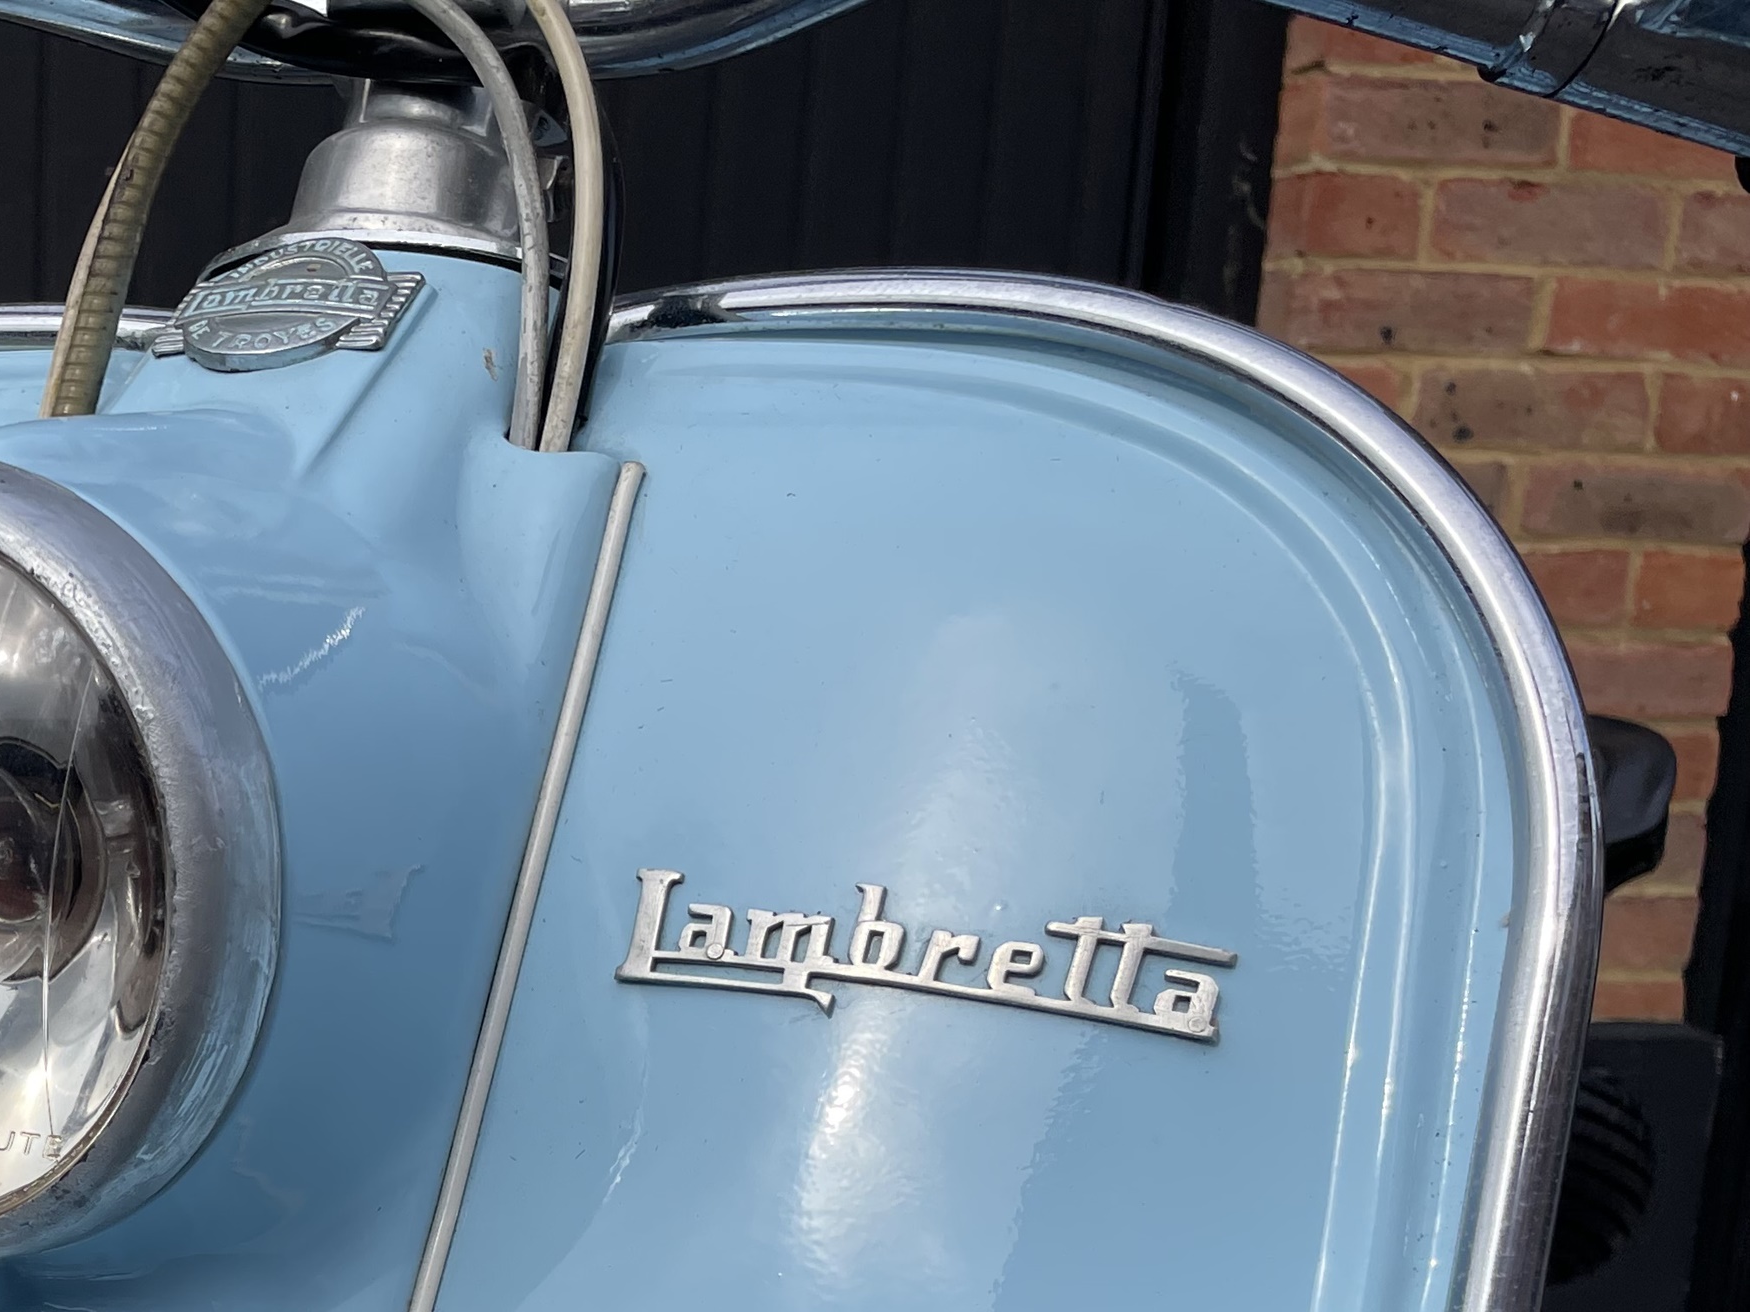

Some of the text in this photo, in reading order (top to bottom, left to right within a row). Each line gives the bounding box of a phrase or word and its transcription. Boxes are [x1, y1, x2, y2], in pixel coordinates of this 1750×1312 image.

[228, 238, 374, 279] INDUSTRIELLE
[182, 276, 388, 317] Lambretta
[187, 317, 338, 350] DE TROYES
[614, 867, 1238, 1045] Lambretta
